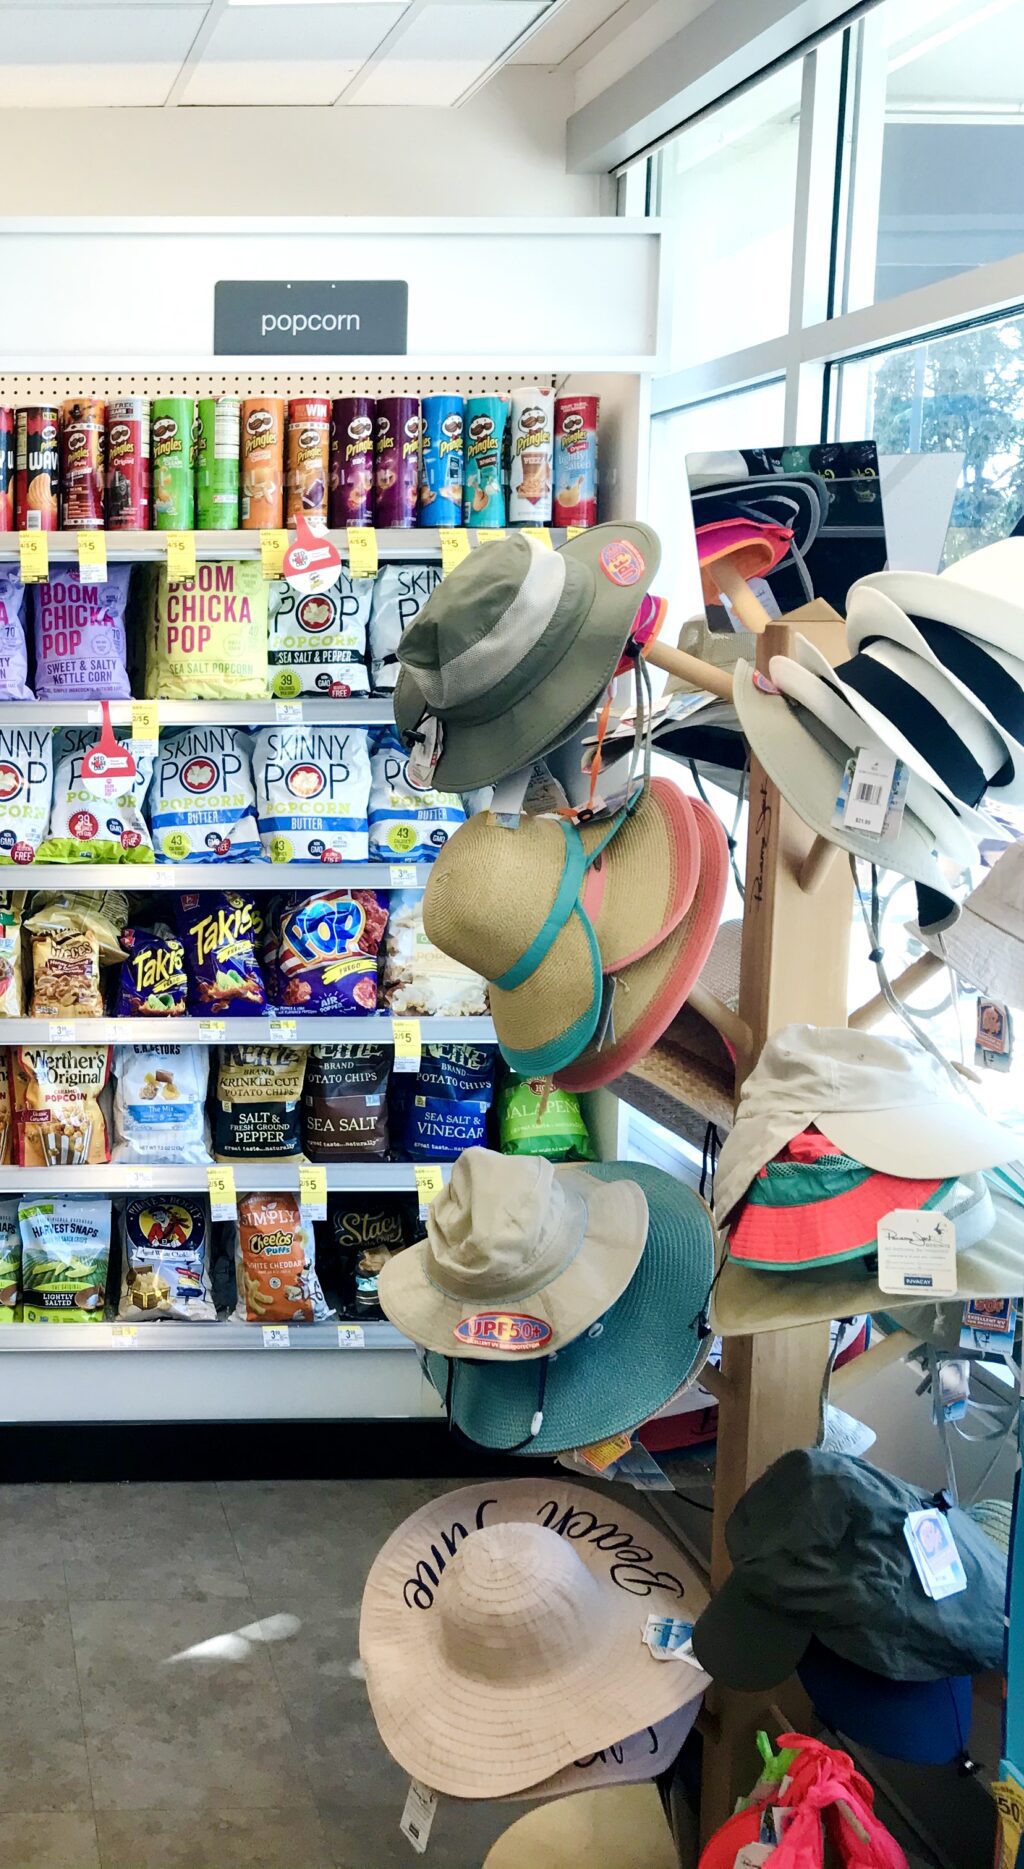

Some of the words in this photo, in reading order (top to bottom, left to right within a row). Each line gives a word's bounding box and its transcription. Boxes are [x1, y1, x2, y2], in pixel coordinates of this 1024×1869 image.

[260, 312, 360, 336] popcorn
[244, 433, 278, 456] Pringles
[516, 430, 551, 456] Pringles
[40, 582, 98, 606] BOOM
[167, 594, 252, 624] CHICKA
[41, 604, 116, 632] CHICKA
[42, 630, 82, 659] POP
[167, 625, 211, 654] POP
[274, 634, 359, 649] POPCORN
[278, 651, 292, 664] SEA
[294, 651, 312, 664] SALT
[313, 651, 320, 662] &
[321, 650, 352, 662] PEPPER
[46, 661, 76, 674] SWEET
[80, 660, 87, 672] &
[90, 659, 117, 671] SALTY
[54, 672, 86, 684] KETTLE
[88, 670, 112, 682] CORN
[280, 674, 293, 686] 39
[331, 689, 347, 698] FREE
[162, 728, 239, 761] SKINNY
[266, 734, 350, 762] SKINNY
[264, 762, 350, 801] POP
[158, 794, 246, 811] POPCORN
[266, 800, 351, 816] POPCORN
[187, 812, 219, 823] BUTTER
[418, 808, 448, 820] BUTTER
[290, 818, 323, 830] BUTTER
[171, 836, 182, 846] 43
[396, 828, 409, 839] 43
[14, 851, 32, 861] FREE
[283, 900, 365, 964] POP
[134, 949, 184, 992] Takis
[338, 961, 362, 975] FUEGO
[26, 1050, 105, 1070] Werther's
[324, 1062, 355, 1070] BRAND
[48, 1067, 102, 1087] Original
[243, 1068, 275, 1076] BRAND
[441, 1062, 466, 1077] BRAND
[220, 1077, 272, 1088] KRINKLE
[275, 1077, 300, 1086] CUT
[308, 1073, 341, 1084] OTATO
[344, 1072, 378, 1082] CHIPS
[416, 1072, 458, 1087] POTATO
[460, 1080, 492, 1090] CHIPS
[225, 1088, 263, 1097] POTATO
[265, 1088, 294, 1096] CHIPS
[238, 1112, 270, 1124] SALT
[271, 1114, 281, 1124] &
[307, 1116, 335, 1132] SEA
[339, 1116, 378, 1131] SALT
[424, 1111, 443, 1123] SEA
[446, 1113, 471, 1125] SALT
[472, 1117, 481, 1125] &
[235, 1132, 284, 1143] PEPPER
[416, 1122, 484, 1140] VINEGAR
[241, 1210, 295, 1226] SIMPLY
[249, 1231, 294, 1254] Cheetos
[42, 1293, 74, 1301] LIGHTLY
[44, 1299, 72, 1307] SALTED
[470, 1320, 507, 1336] UPF
[510, 1322, 542, 1339] 50+
